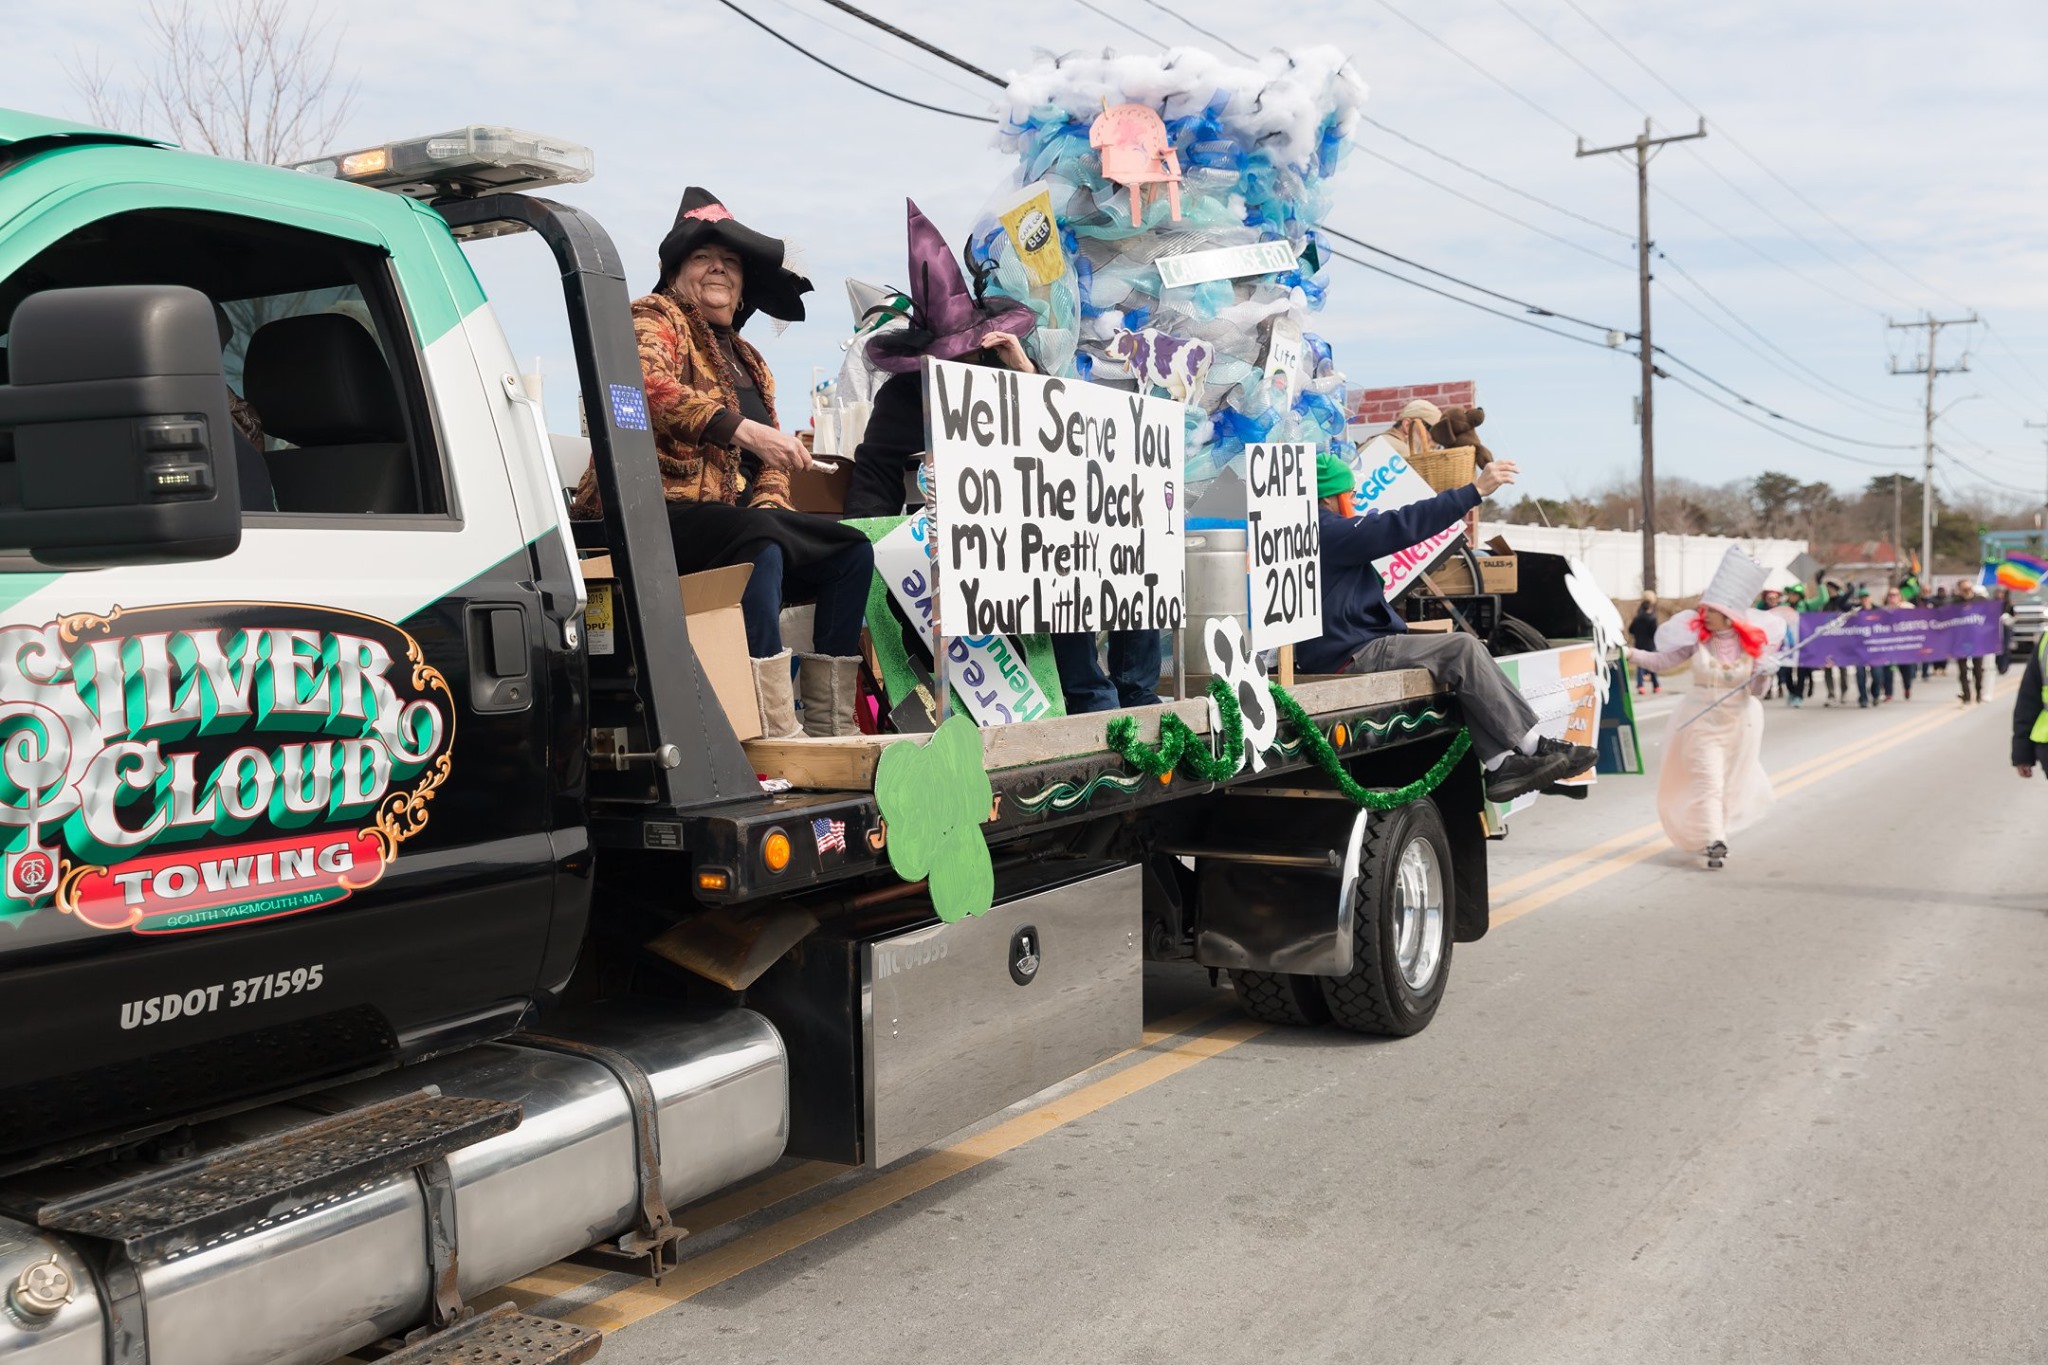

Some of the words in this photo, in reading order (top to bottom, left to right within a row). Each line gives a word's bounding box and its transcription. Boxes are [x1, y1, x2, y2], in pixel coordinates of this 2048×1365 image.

[1027, 222, 1050, 248] BEER
[1038, 378, 1116, 463] Serve
[1129, 395, 1172, 470] You
[958, 467, 1002, 516] on
[1014, 456, 1076, 521] The
[1087, 460, 1144, 528] Deck
[1250, 444, 1307, 498] CAPE
[1110, 528, 1145, 576] and
[1248, 500, 1320, 567] Tornado
[959, 577, 1030, 635] Your
[1033, 578, 1094, 633] Little
[1144, 572, 1186, 631] Too!
[1263, 560, 1317, 627] 2019
[0, 624, 443, 815] SILVER
[72, 736, 395, 848] CLOUD
[113, 841, 355, 905] TOWING
[167, 910, 219, 928] SOUTH
[120, 983, 225, 1030] USDOT
[229, 963, 324, 1008] 371595
